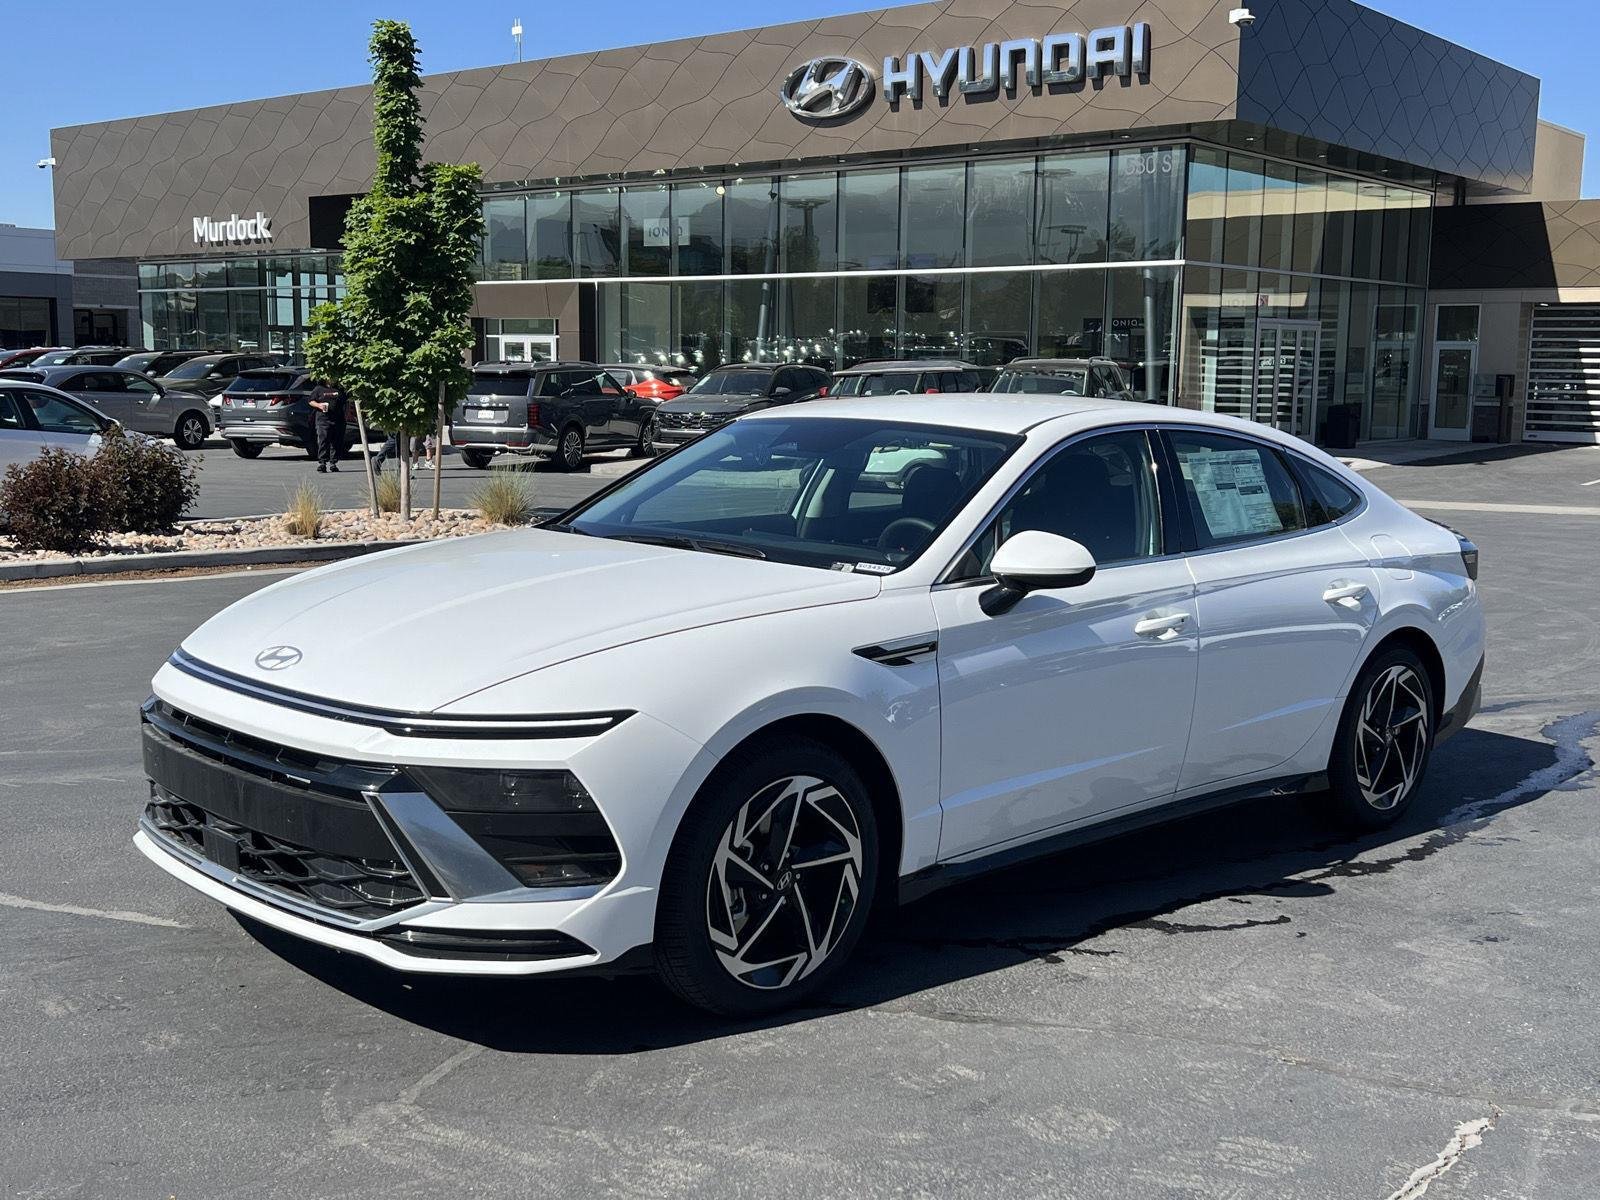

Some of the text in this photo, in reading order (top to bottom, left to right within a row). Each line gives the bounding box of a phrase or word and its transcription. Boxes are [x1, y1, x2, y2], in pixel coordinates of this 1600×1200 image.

[883, 22, 1150, 103] HYUNDAI
[1162, 153, 1172, 173] S
[193, 211, 272, 243] Murdock
[648, 226, 683, 237] IONQ
